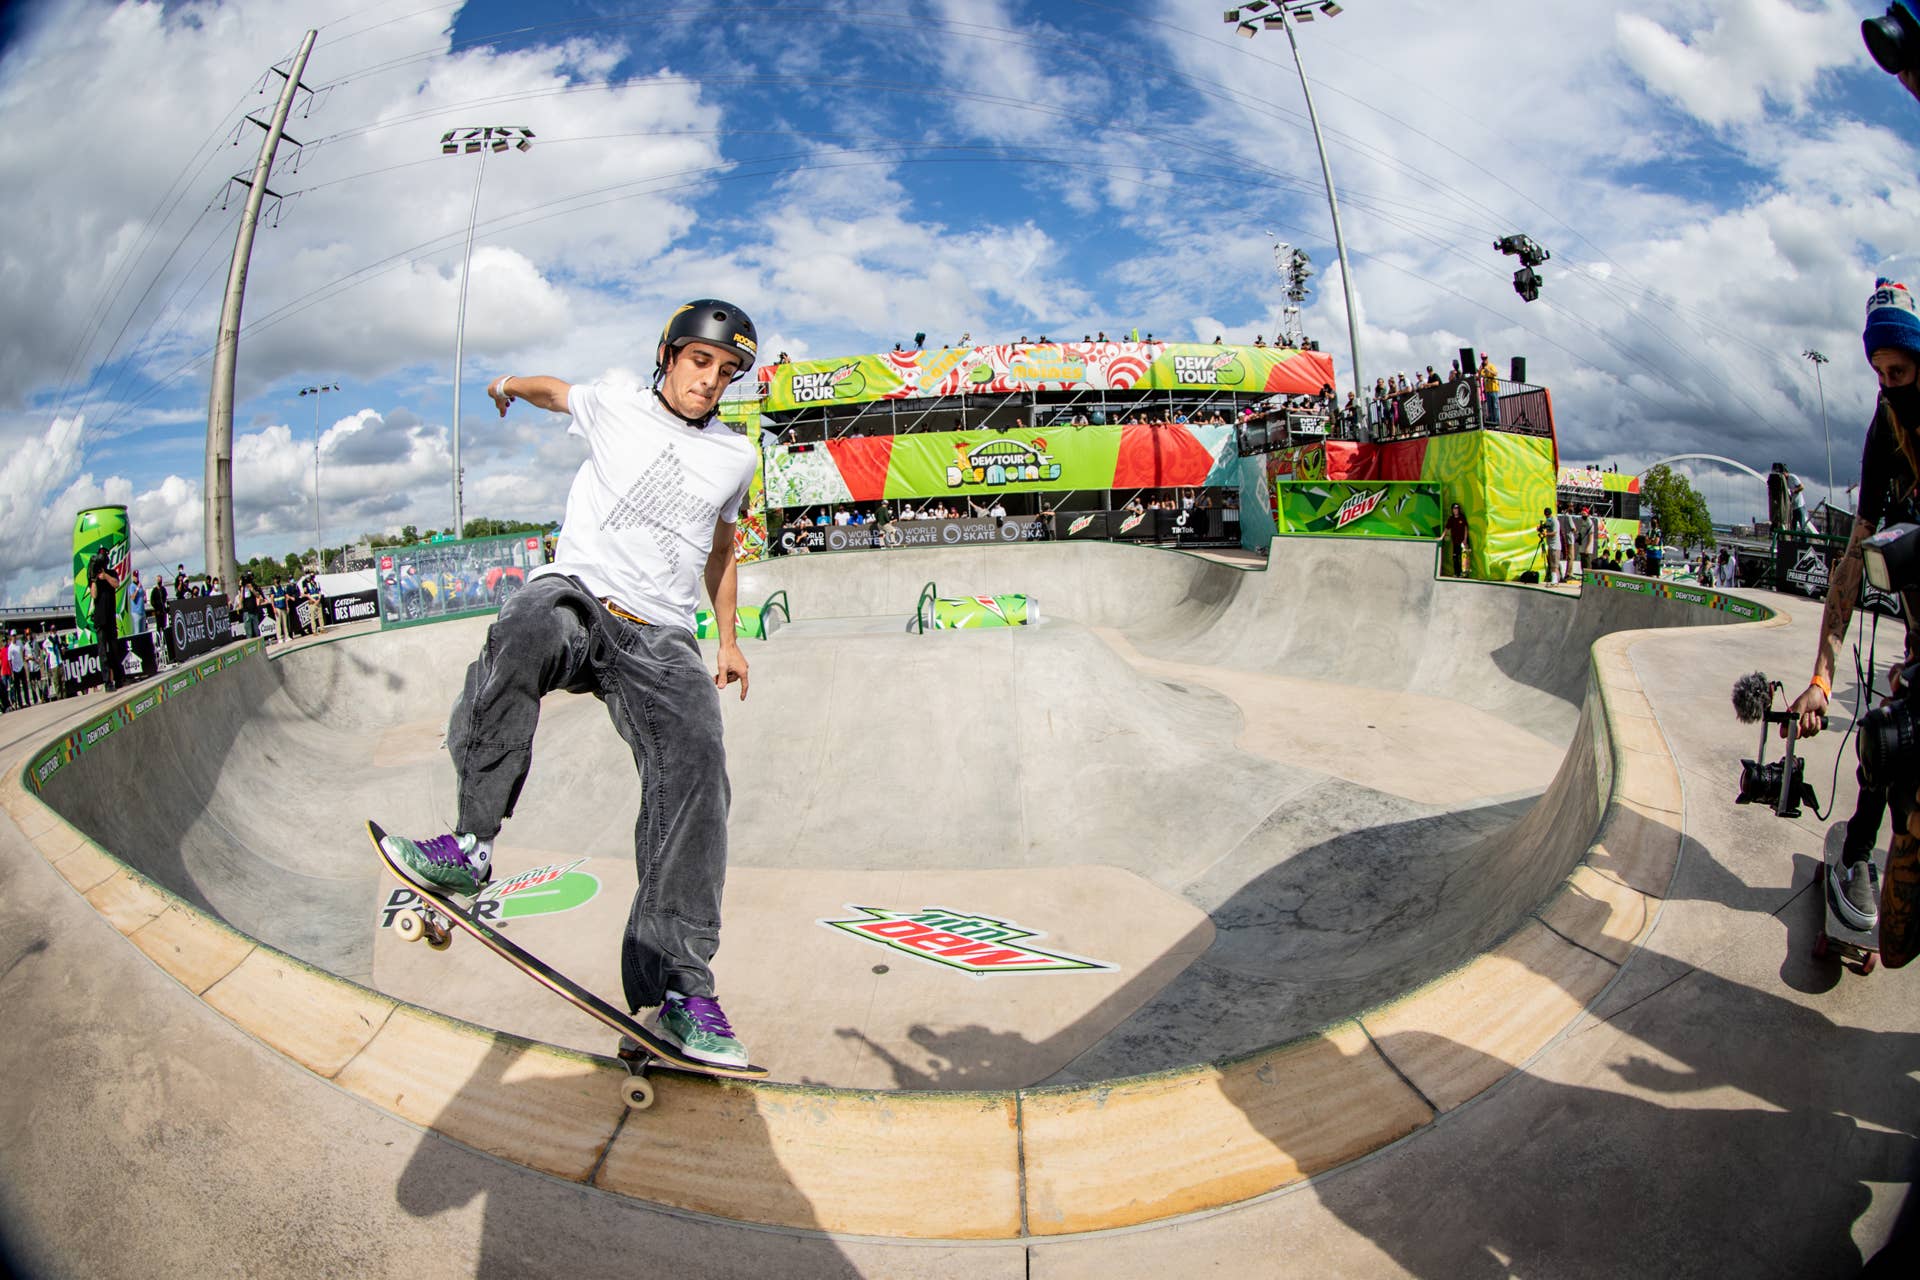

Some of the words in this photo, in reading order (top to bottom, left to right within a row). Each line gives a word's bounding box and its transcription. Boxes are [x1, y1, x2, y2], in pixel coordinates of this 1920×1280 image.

[1174, 356, 1212, 370] DEW
[792, 372, 832, 389] DEW
[1176, 369, 1217, 384] TOUR
[793, 386, 835, 402] TOUR
[971, 453, 1025, 467] DEWTOUR
[986, 464, 1062, 485] MOINES
[905, 526, 937, 535] WORLD
[962, 523, 995, 533] WORLD
[1021, 521, 1041, 530] WOR
[848, 530, 880, 539] WORLD
[905, 534, 938, 543] SKATE
[962, 531, 996, 541] SKATE
[1021, 529, 1042, 538] SKA
[848, 537, 880, 547] SKATE
[1788, 571, 1807, 582] PRAIRIE
[1808, 574, 1828, 586] MEADOW
[1615, 580, 1641, 591] DEWTOUR
[334, 598, 356, 608] CATCH
[1675, 591, 1703, 603] DEWTOUR
[335, 607, 348, 620] DES
[349, 602, 376, 619] MOINES
[185, 610, 204, 627] WORLD
[216, 618, 231, 634] SKATE
[186, 625, 206, 643] SKATE
[87, 722, 110, 745] DEWTOUR
